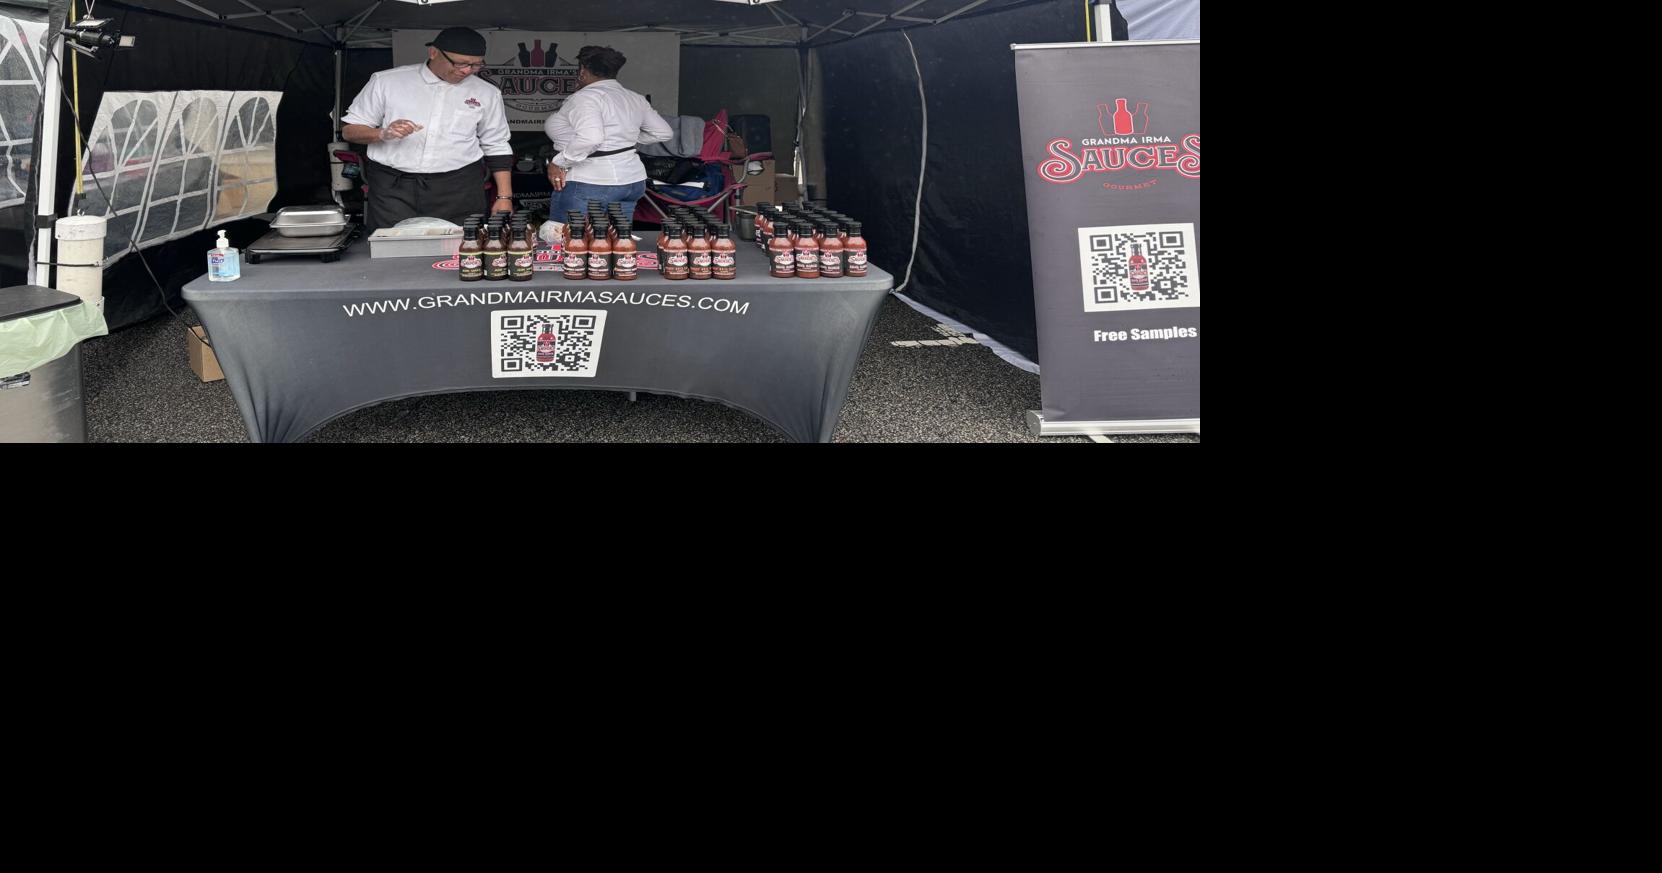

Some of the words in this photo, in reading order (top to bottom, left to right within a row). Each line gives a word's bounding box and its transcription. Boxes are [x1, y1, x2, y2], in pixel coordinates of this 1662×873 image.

[1081, 137, 1138, 146] GRANDMA
[1141, 135, 1172, 144] IRMA
[1037, 133, 1200, 183] SAUCES
[342, 290, 750, 317] WWW.GRANDMAIRMASAUCES.COM
[1093, 330, 1128, 342] Free
[1130, 326, 1198, 340] Samples
